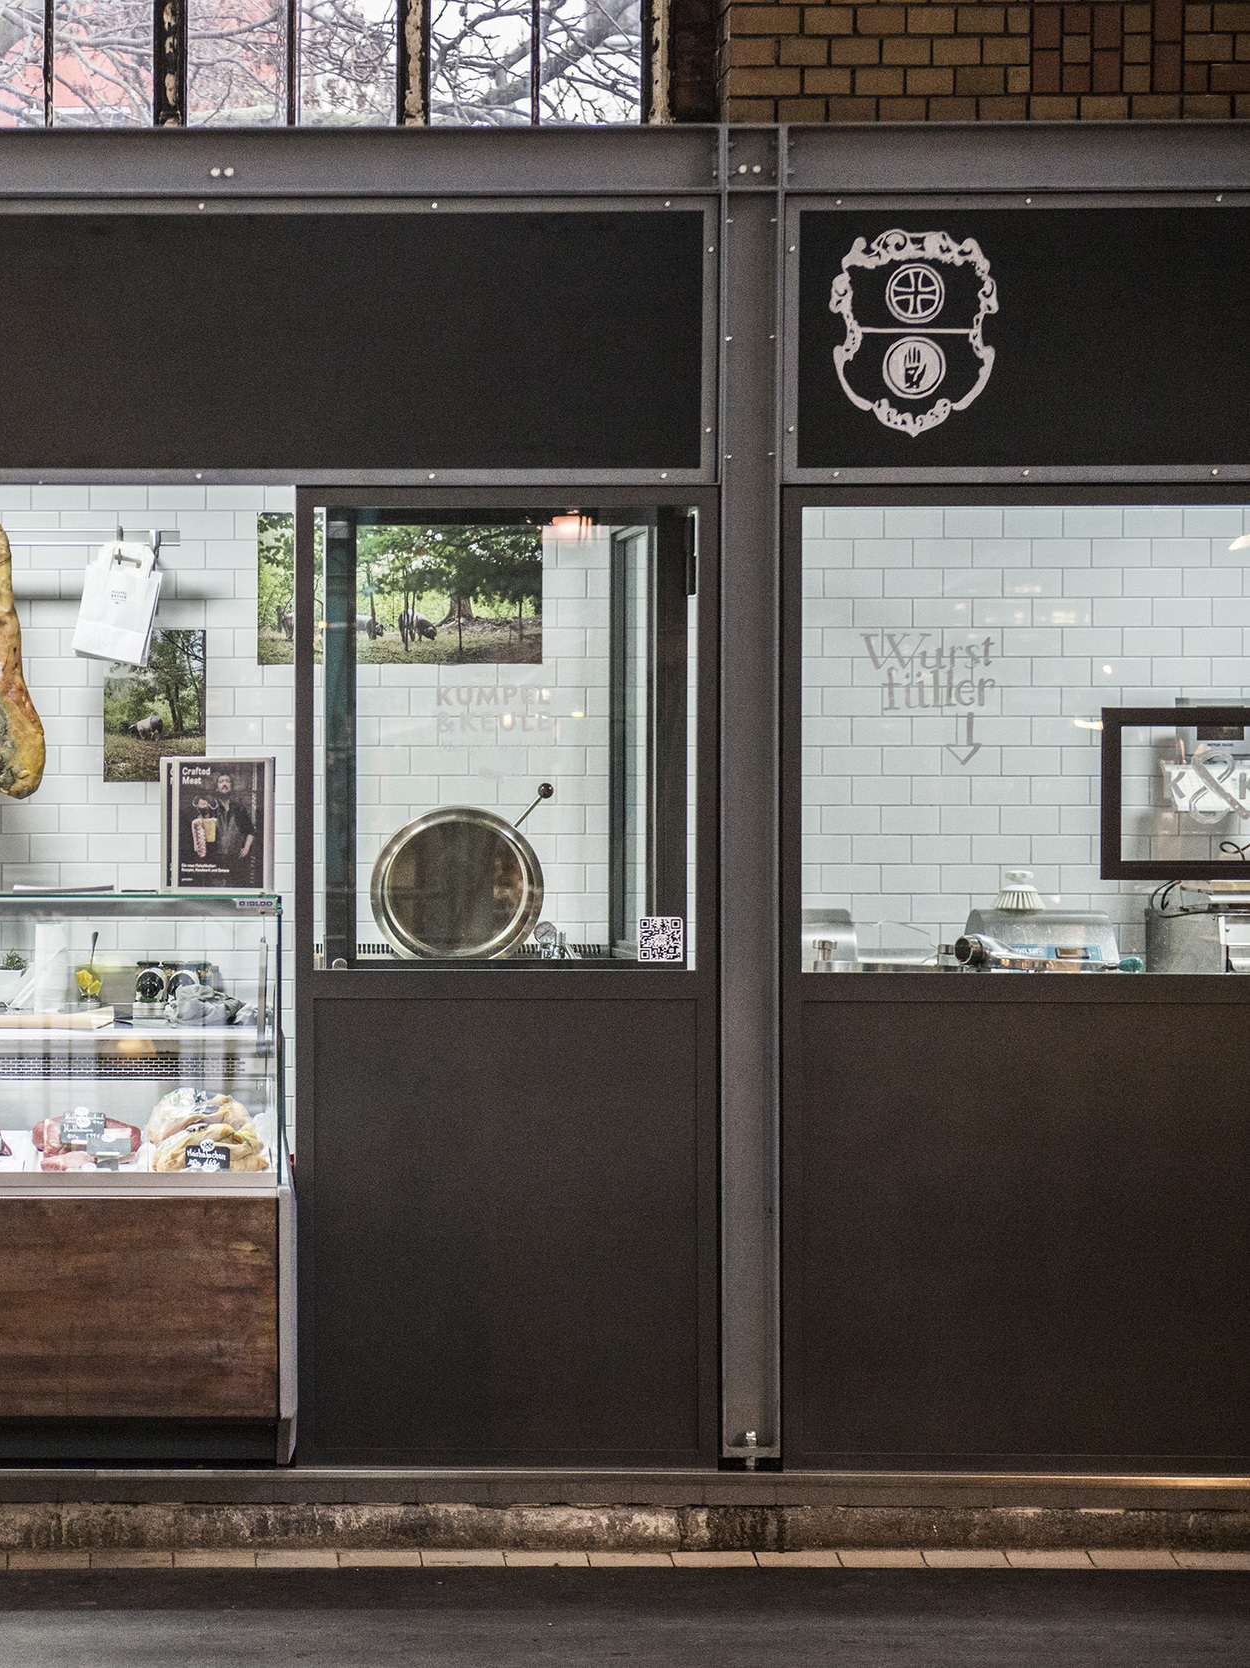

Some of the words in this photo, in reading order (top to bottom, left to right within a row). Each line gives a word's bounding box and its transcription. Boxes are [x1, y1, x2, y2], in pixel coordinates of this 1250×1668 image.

[859, 632, 996, 670] Wurst
[436, 684, 551, 707] KUMPEL
[882, 665, 996, 711] füller
[459, 711, 551, 733] KEULE
[182, 767, 211, 776] Crafted
[182, 777, 202, 785] Meat
